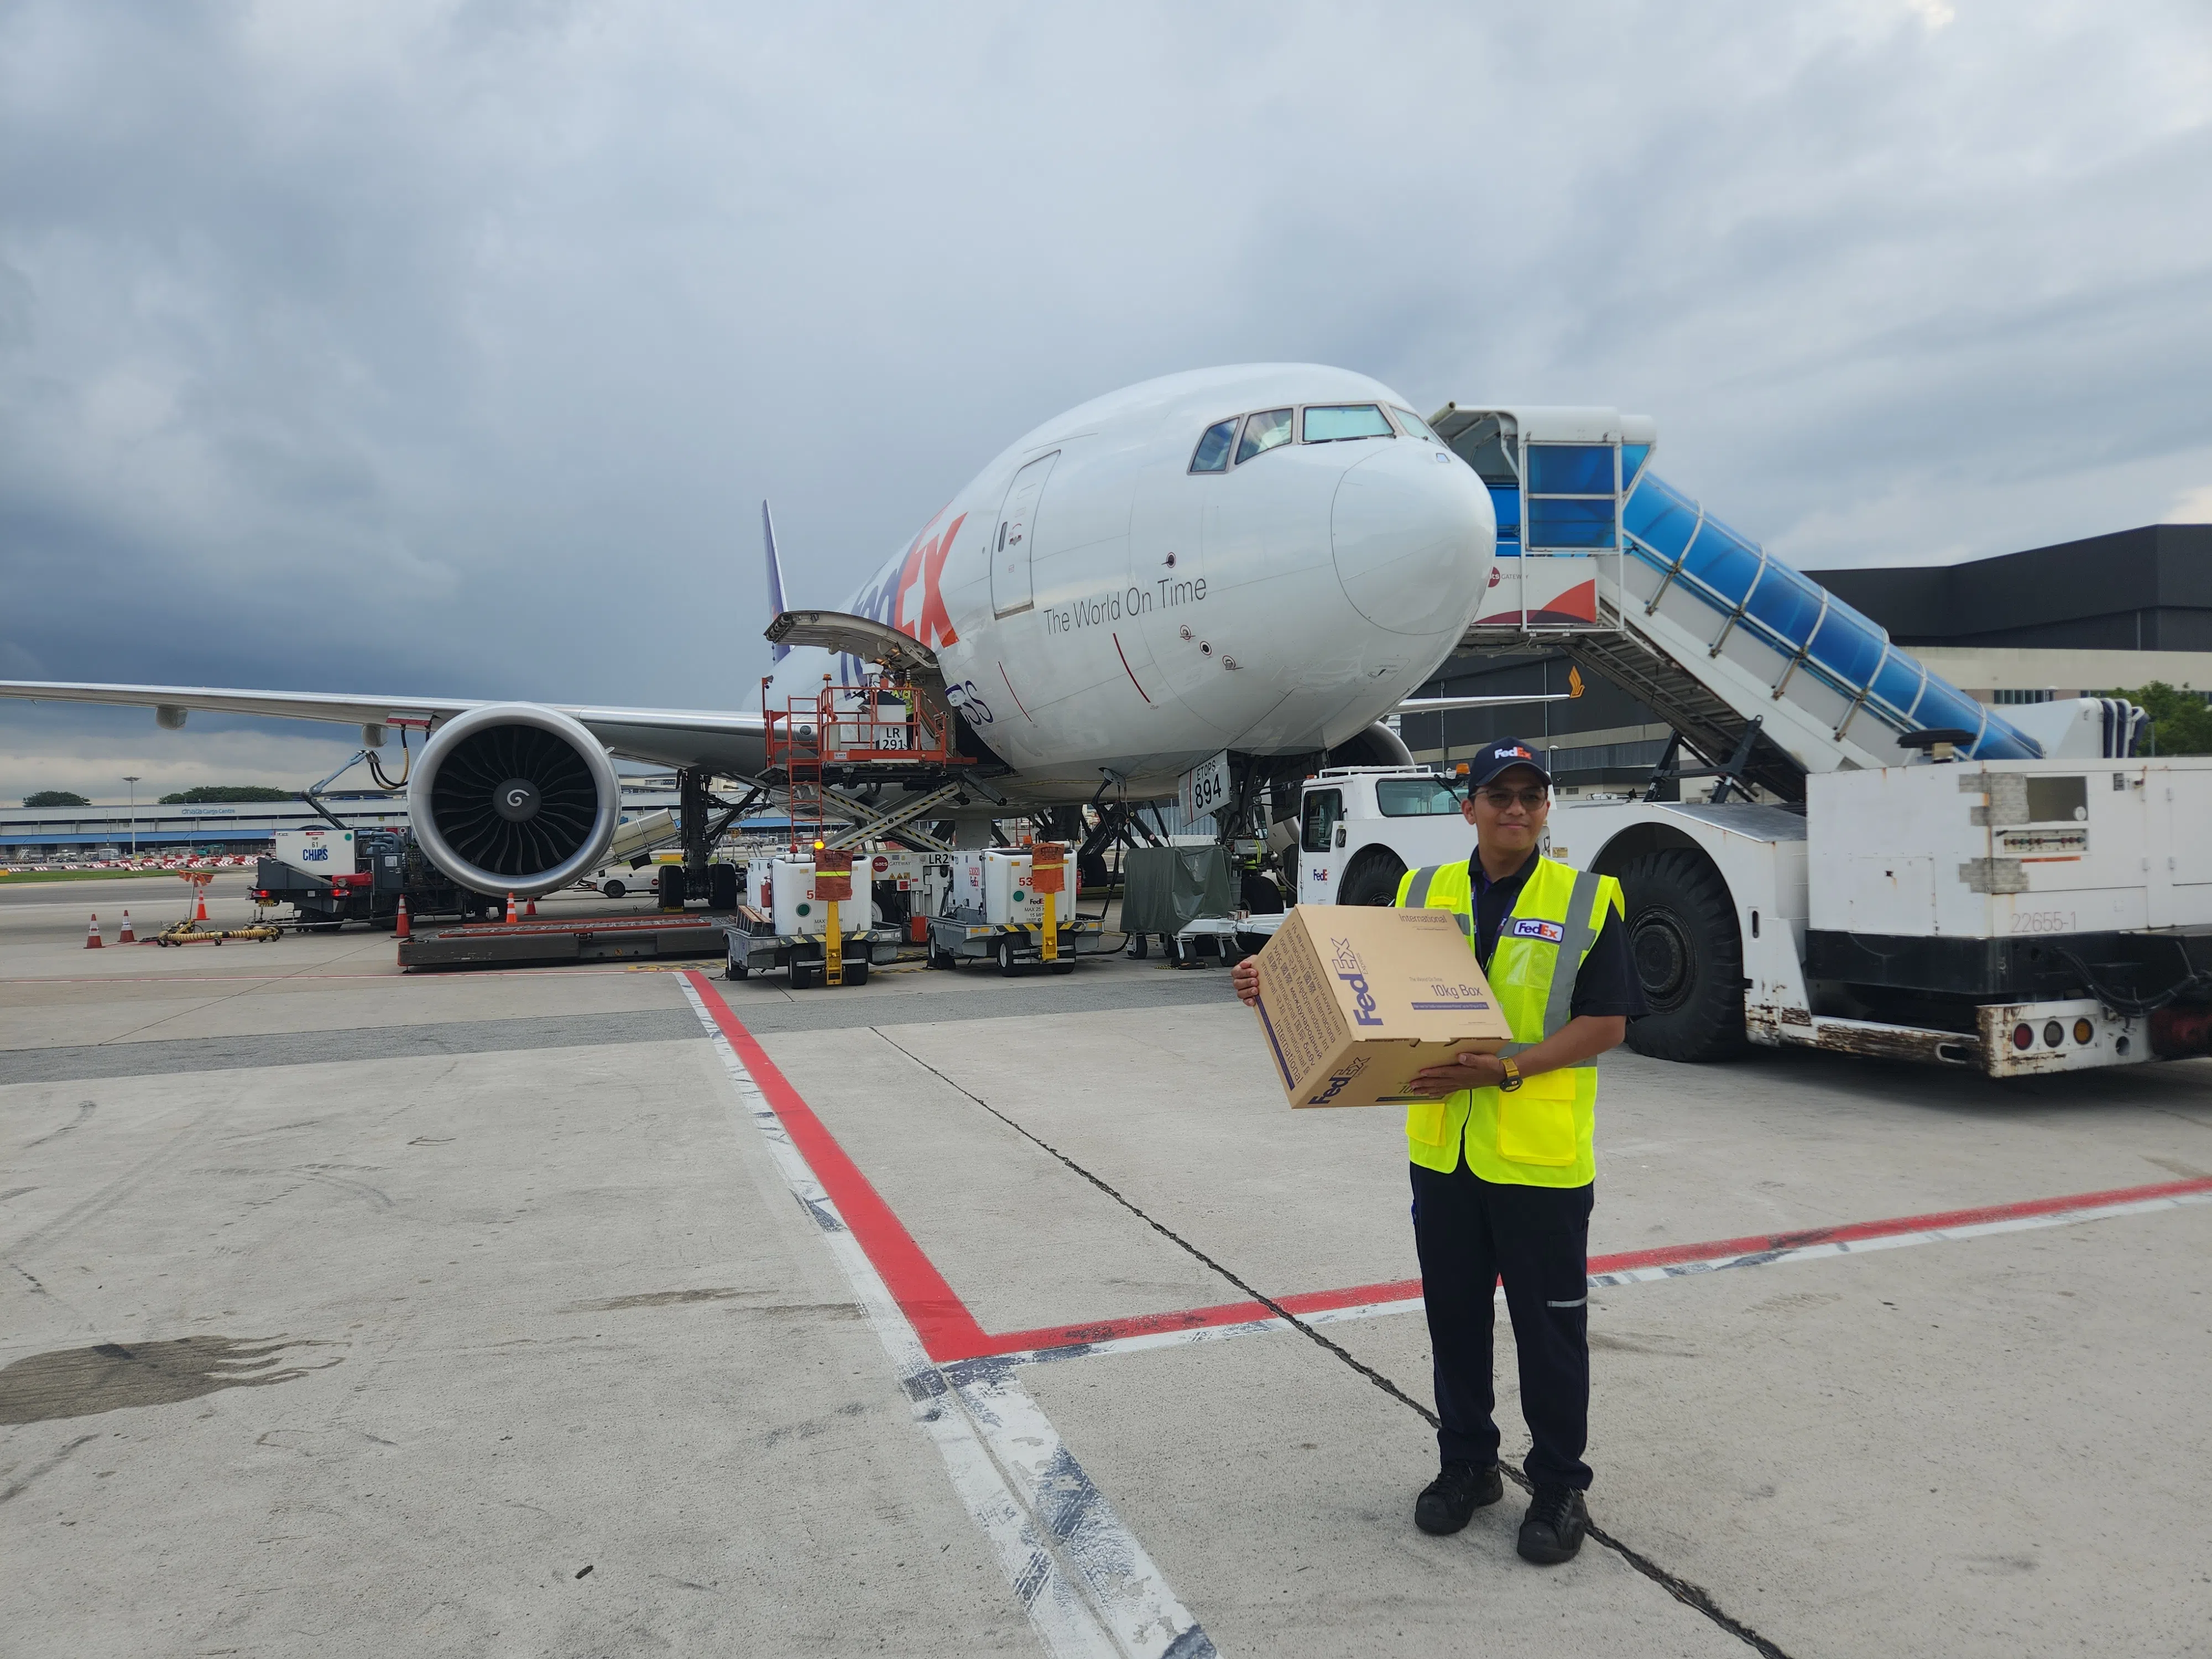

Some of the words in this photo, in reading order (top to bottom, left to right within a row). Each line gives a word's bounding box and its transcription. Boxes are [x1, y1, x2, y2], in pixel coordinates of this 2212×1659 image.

[1044, 608, 1070, 635] The
[1073, 591, 1120, 628] World
[1126, 587, 1152, 616] On
[1157, 577, 1206, 608] Time
[886, 728, 900, 738] LR
[883, 739, 905, 750] 291
[1494, 746, 1532, 760] FedEx
[1197, 760, 1216, 781] ETOPS
[1195, 773, 1222, 809] 894
[302, 848, 328, 861] CHIPS
[929, 854, 951, 864] LR2
[1019, 877, 1033, 886] 53
[1313, 869, 1327, 881] FedE
[1399, 914, 1447, 923] International
[2011, 911, 2076, 933] 22655-1
[1518, 922, 1558, 940] FedEx
[1355, 952, 1368, 974] Express
[1279, 935, 1290, 956] ional
[1295, 975, 1324, 1041] Międzynarodowy
[1331, 937, 1384, 1025] FedEx
[1431, 984, 1459, 999] 10kg
[1458, 984, 1483, 996] Box
[1275, 972, 1297, 1021] Internacional
[1289, 985, 1323, 1060] международный
[1313, 994, 1336, 1044] Internaciona
[1274, 1018, 1303, 1084] International
[1282, 1014, 1307, 1068] Internationaal
[1307, 1057, 1371, 1104] FedEx
